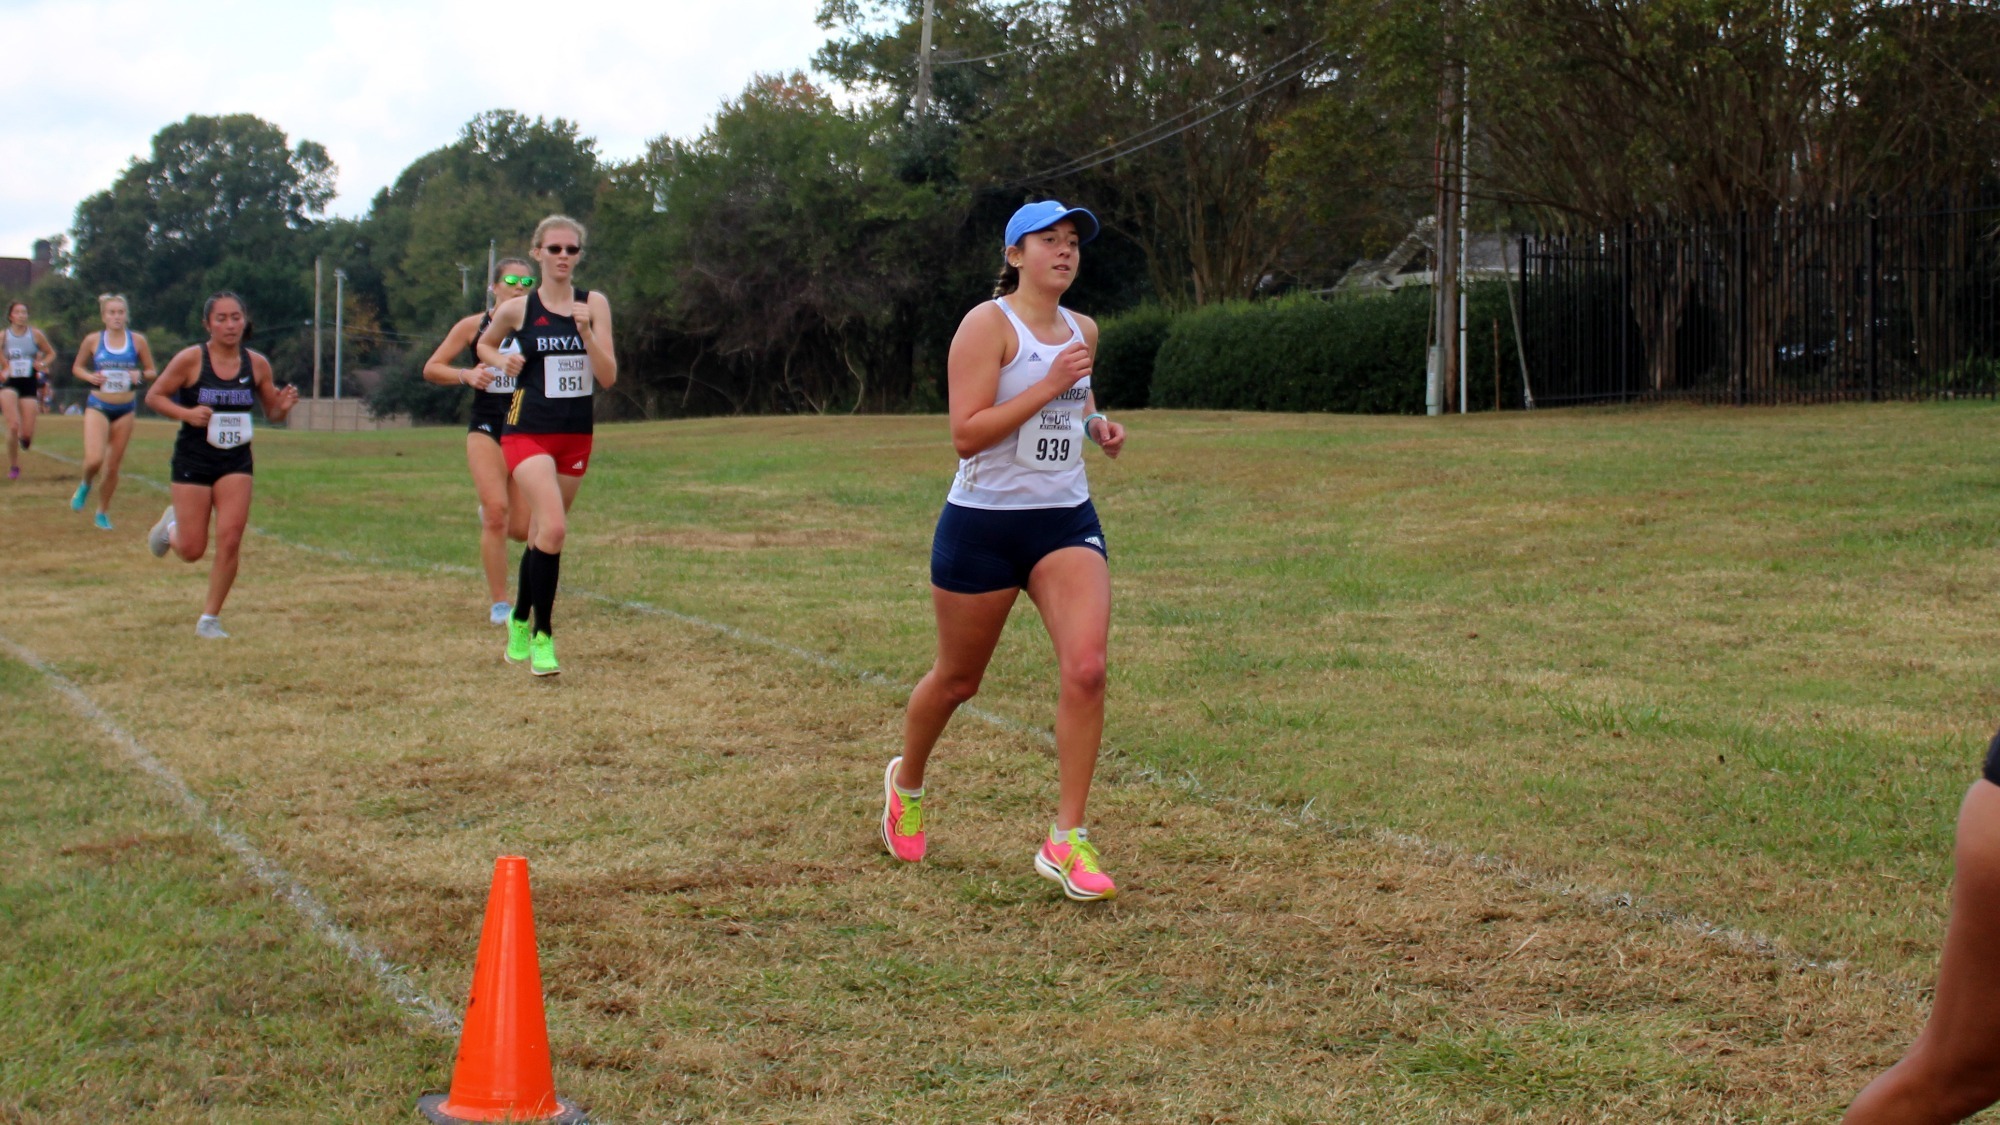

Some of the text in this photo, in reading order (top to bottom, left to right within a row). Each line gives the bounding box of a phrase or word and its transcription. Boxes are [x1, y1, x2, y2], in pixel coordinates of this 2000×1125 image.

[537, 336, 585, 351] BRYA
[559, 376, 583, 391] 851
[198, 388, 253, 405] BETHEL
[219, 432, 241, 445] 835
[1036, 438, 1070, 461] 939
